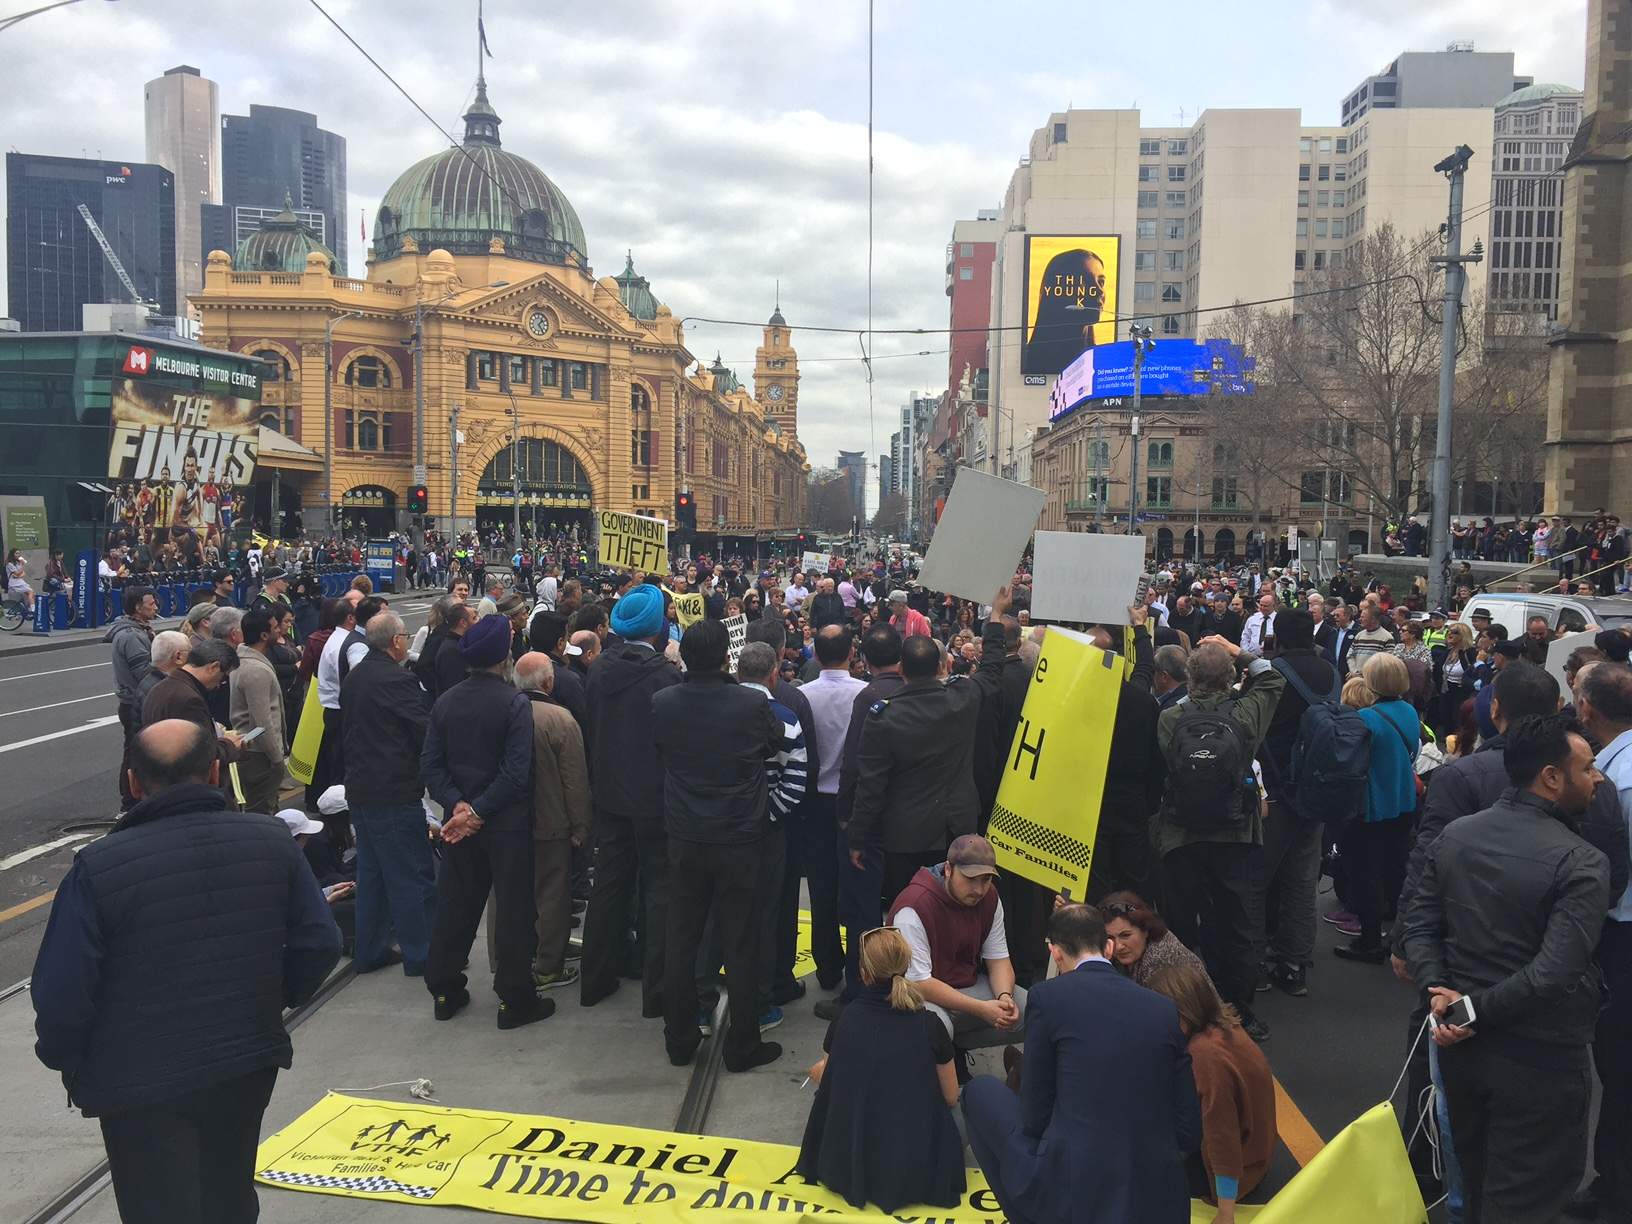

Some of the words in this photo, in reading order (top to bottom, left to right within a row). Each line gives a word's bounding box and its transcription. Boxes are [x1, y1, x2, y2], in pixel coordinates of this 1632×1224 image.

[106, 175, 126, 184] pwc
[1055, 275, 1083, 285] THI
[1044, 286, 1097, 297] YOUNG
[1077, 298, 1085, 308] K
[155, 356, 200, 378] MELBOURNE
[202, 366, 229, 383] VISITOR
[231, 372, 257, 388] CENTRE
[1103, 398, 1122, 406] APN
[172, 394, 213, 427] THE
[601, 511, 664, 541] GOVERNMENT
[603, 532, 665, 571] THEFT
[723, 615, 745, 628] hind
[729, 627, 744, 638] ery
[990, 835, 1012, 851] Car
[1014, 847, 1078, 881] Families
[507, 1128, 738, 1179] Daniel
[331, 1163, 387, 1173] Families
[382, 1156, 393, 1164] &
[426, 1160, 451, 1172] Car
[478, 1153, 609, 1202] Time
[623, 1170, 676, 1205] to
